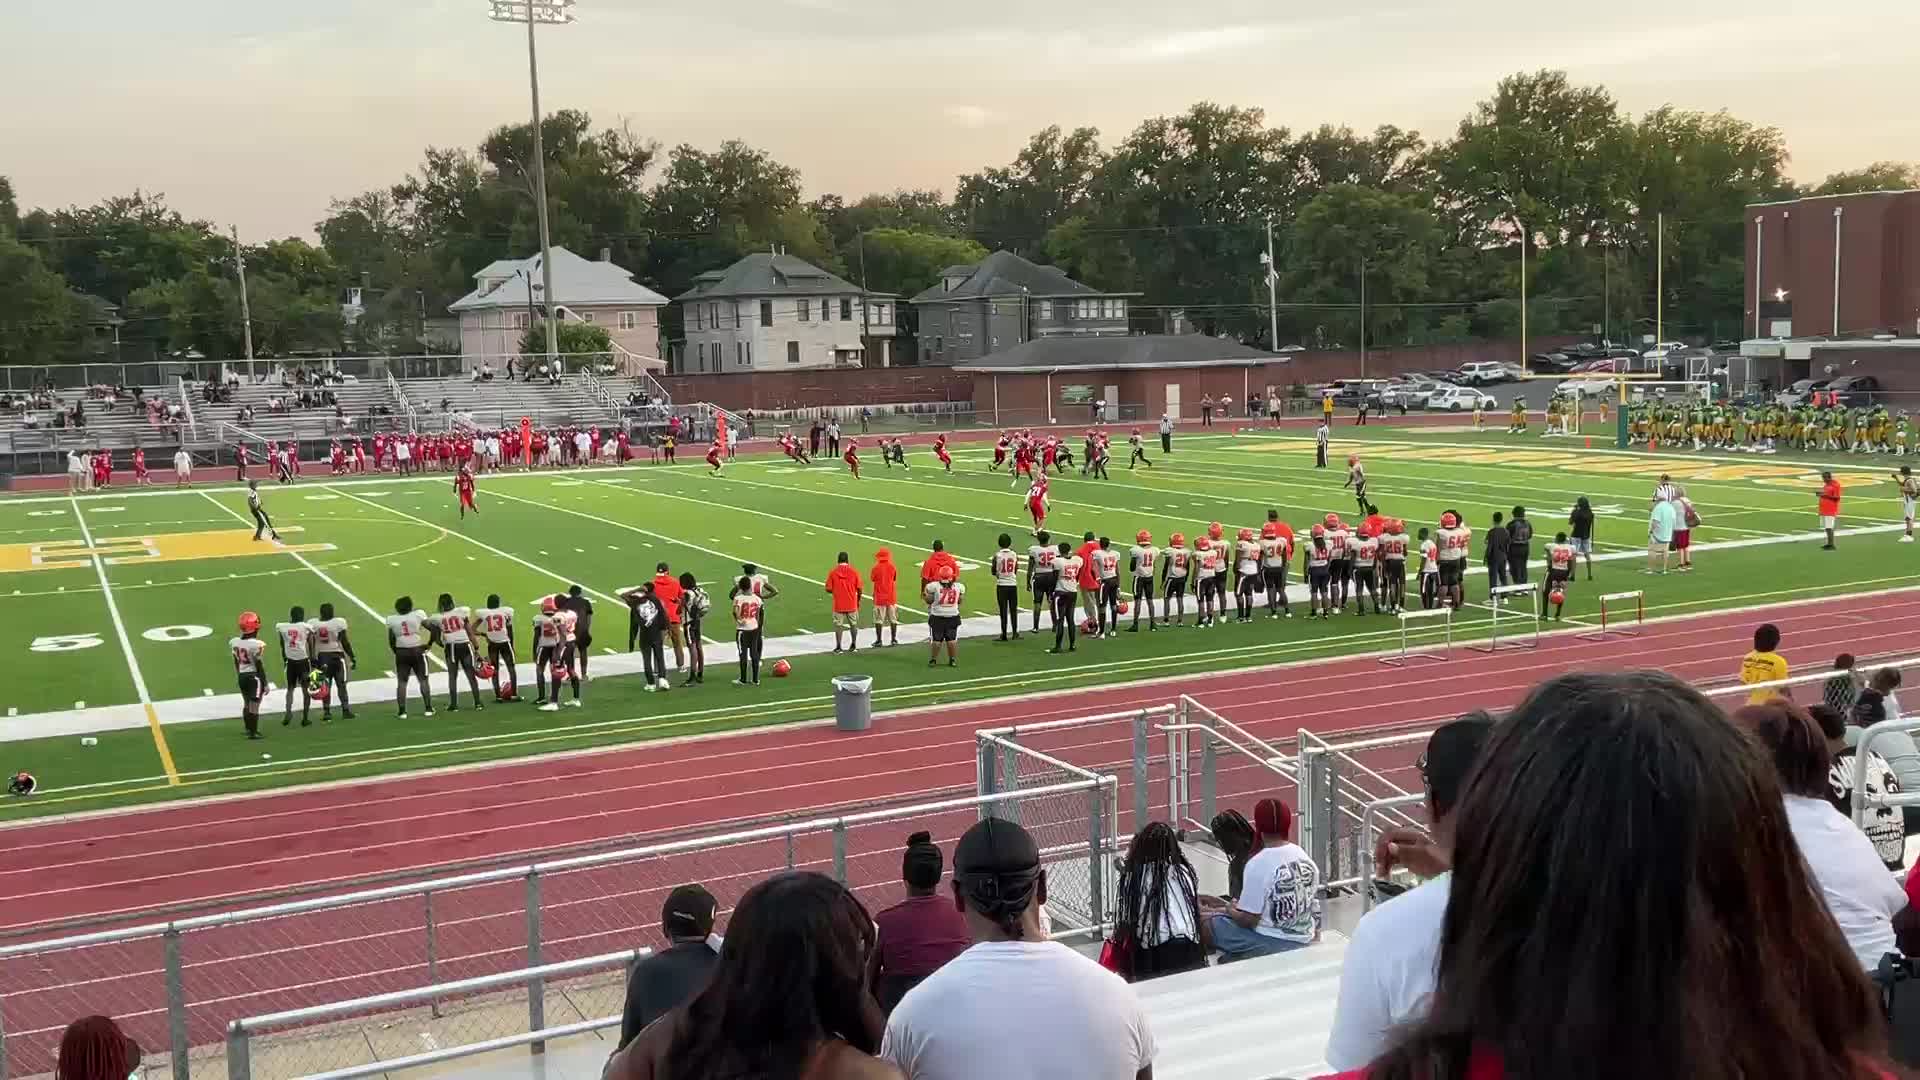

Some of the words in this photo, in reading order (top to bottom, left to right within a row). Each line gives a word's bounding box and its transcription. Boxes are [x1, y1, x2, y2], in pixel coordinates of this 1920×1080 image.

[1038, 551, 1055, 567] 35
[401, 620, 410, 636] 1
[441, 615, 464, 634] 10
[486, 614, 503, 632] 13
[29, 625, 213, 651] 50
[288, 629, 299, 648] 7
